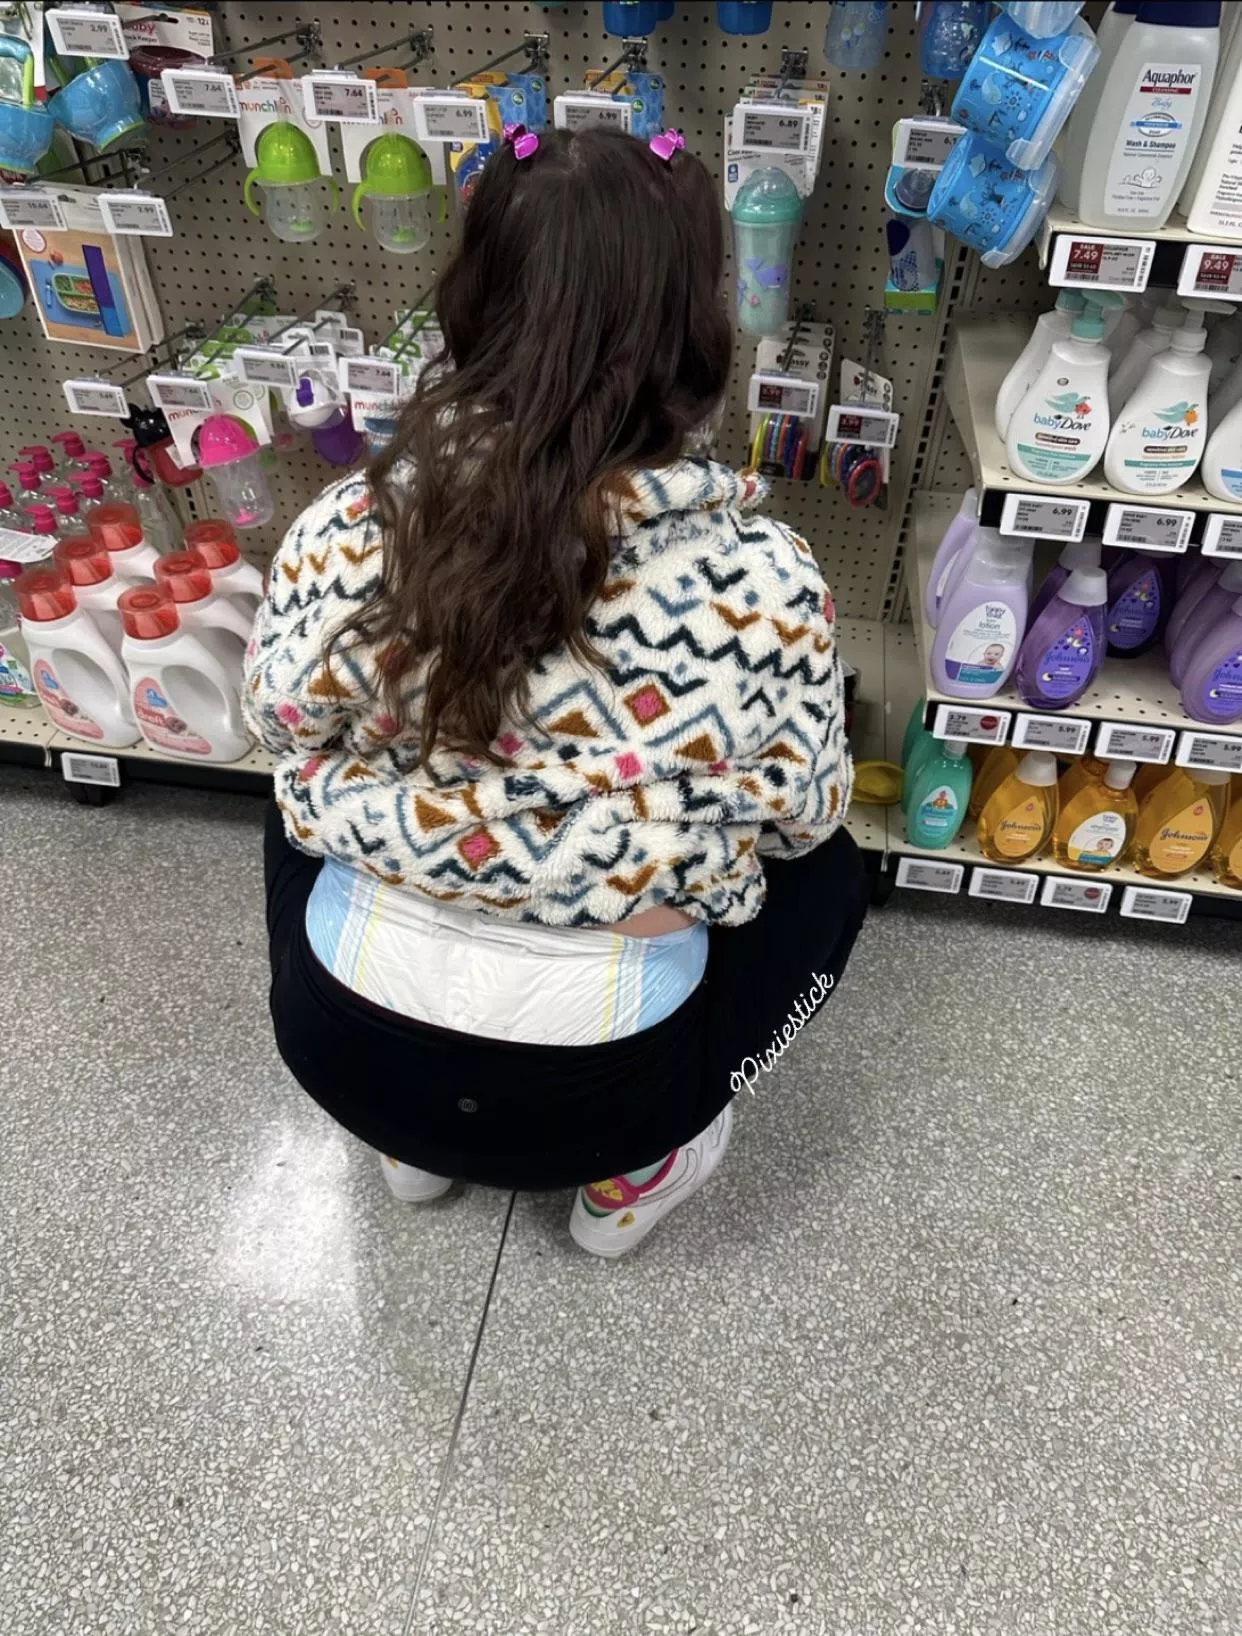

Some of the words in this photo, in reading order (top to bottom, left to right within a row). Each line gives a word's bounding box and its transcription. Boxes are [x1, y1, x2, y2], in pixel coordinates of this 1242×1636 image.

[1142, 69, 1196, 86] Aquaphor
[344, 88, 362, 97] 7.64
[238, 96, 291, 115] munchn
[456, 109, 473, 118] 6.99
[598, 112, 617, 121] 6.99
[779, 119, 799, 128] 6.89
[1072, 249, 1099, 261] 7.49
[1203, 260, 1229, 271] 9.49
[1052, 507, 1073, 516] 6.99
[1156, 517, 1177, 527] 6.99
